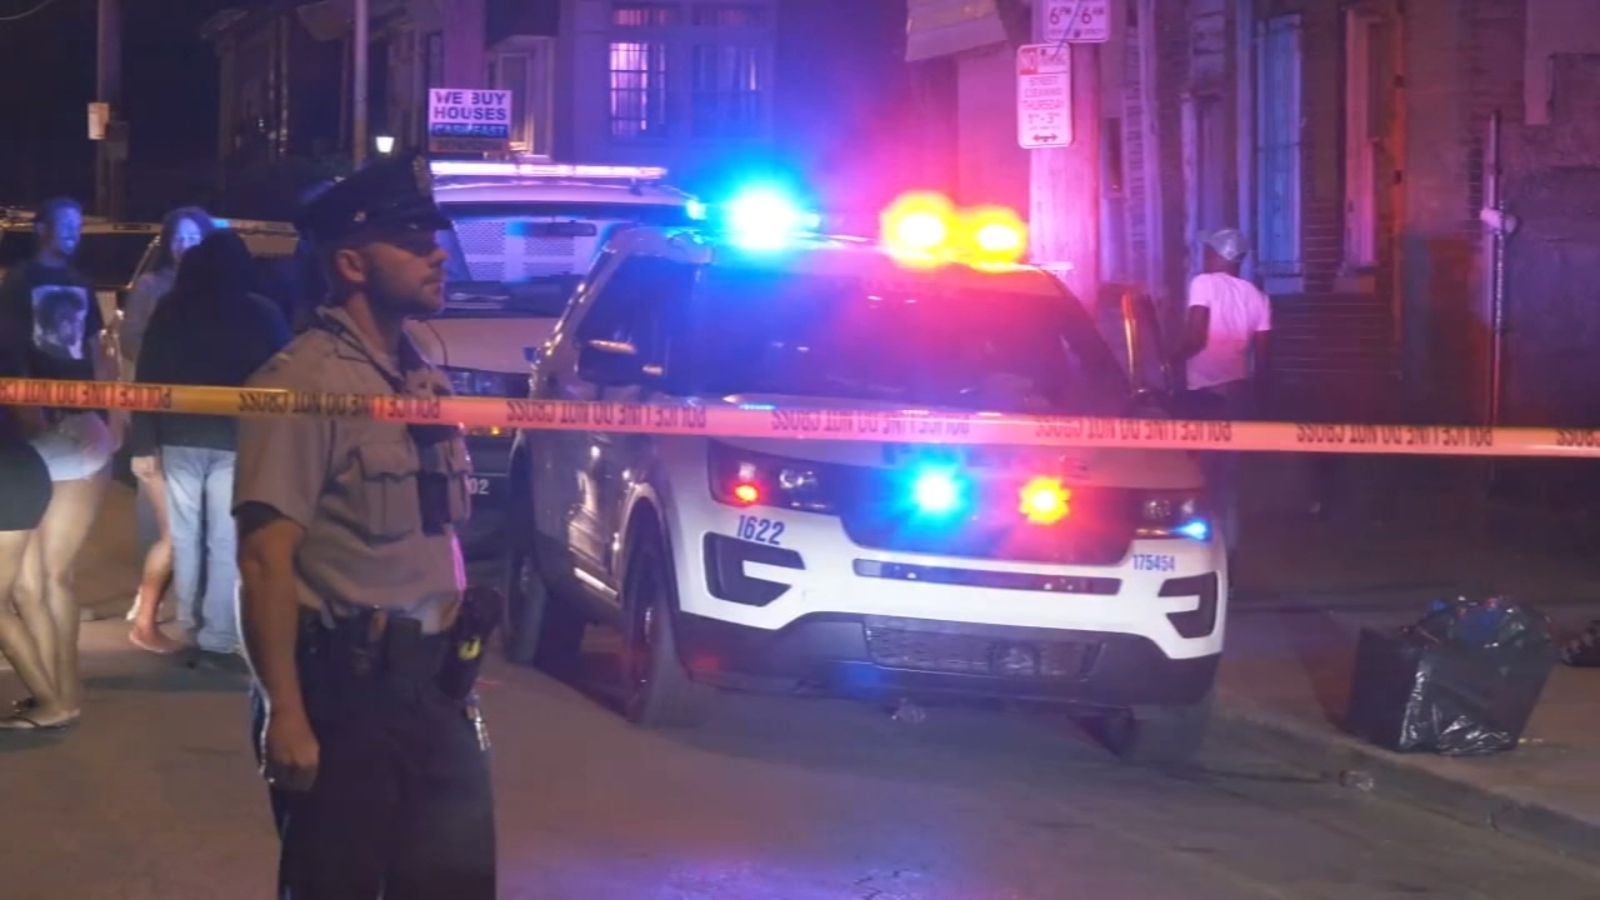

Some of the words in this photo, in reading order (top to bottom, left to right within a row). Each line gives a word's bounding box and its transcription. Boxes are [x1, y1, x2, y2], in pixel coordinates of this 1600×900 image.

[434, 91, 463, 105] WE
[471, 92, 506, 106] BUY
[433, 106, 507, 121] HOUSES
[238, 391, 288, 414] CROSS
[388, 396, 440, 419] POLICE
[506, 401, 555, 423] CROSS
[559, 401, 589, 424] NOT
[592, 402, 614, 425] DO
[617, 403, 650, 426] LINE
[654, 404, 706, 428] POLICE
[771, 410, 819, 431] CROSS
[822, 411, 853, 432] NOT
[1035, 417, 1081, 438] CROSS
[1086, 418, 1116, 440] NOT
[1120, 419, 1140, 441] DO
[1144, 420, 1177, 441] LINE
[1181, 421, 1232, 443] POLICE
[1296, 424, 1345, 444] CROSS
[1349, 425, 1378, 445] NOT
[1380, 426, 1403, 446] DO
[1406, 426, 1440, 446] LINE
[1444, 427, 1494, 448] POLICE
[737, 514, 786, 546] 1622
[1133, 553, 1176, 573] 175454
